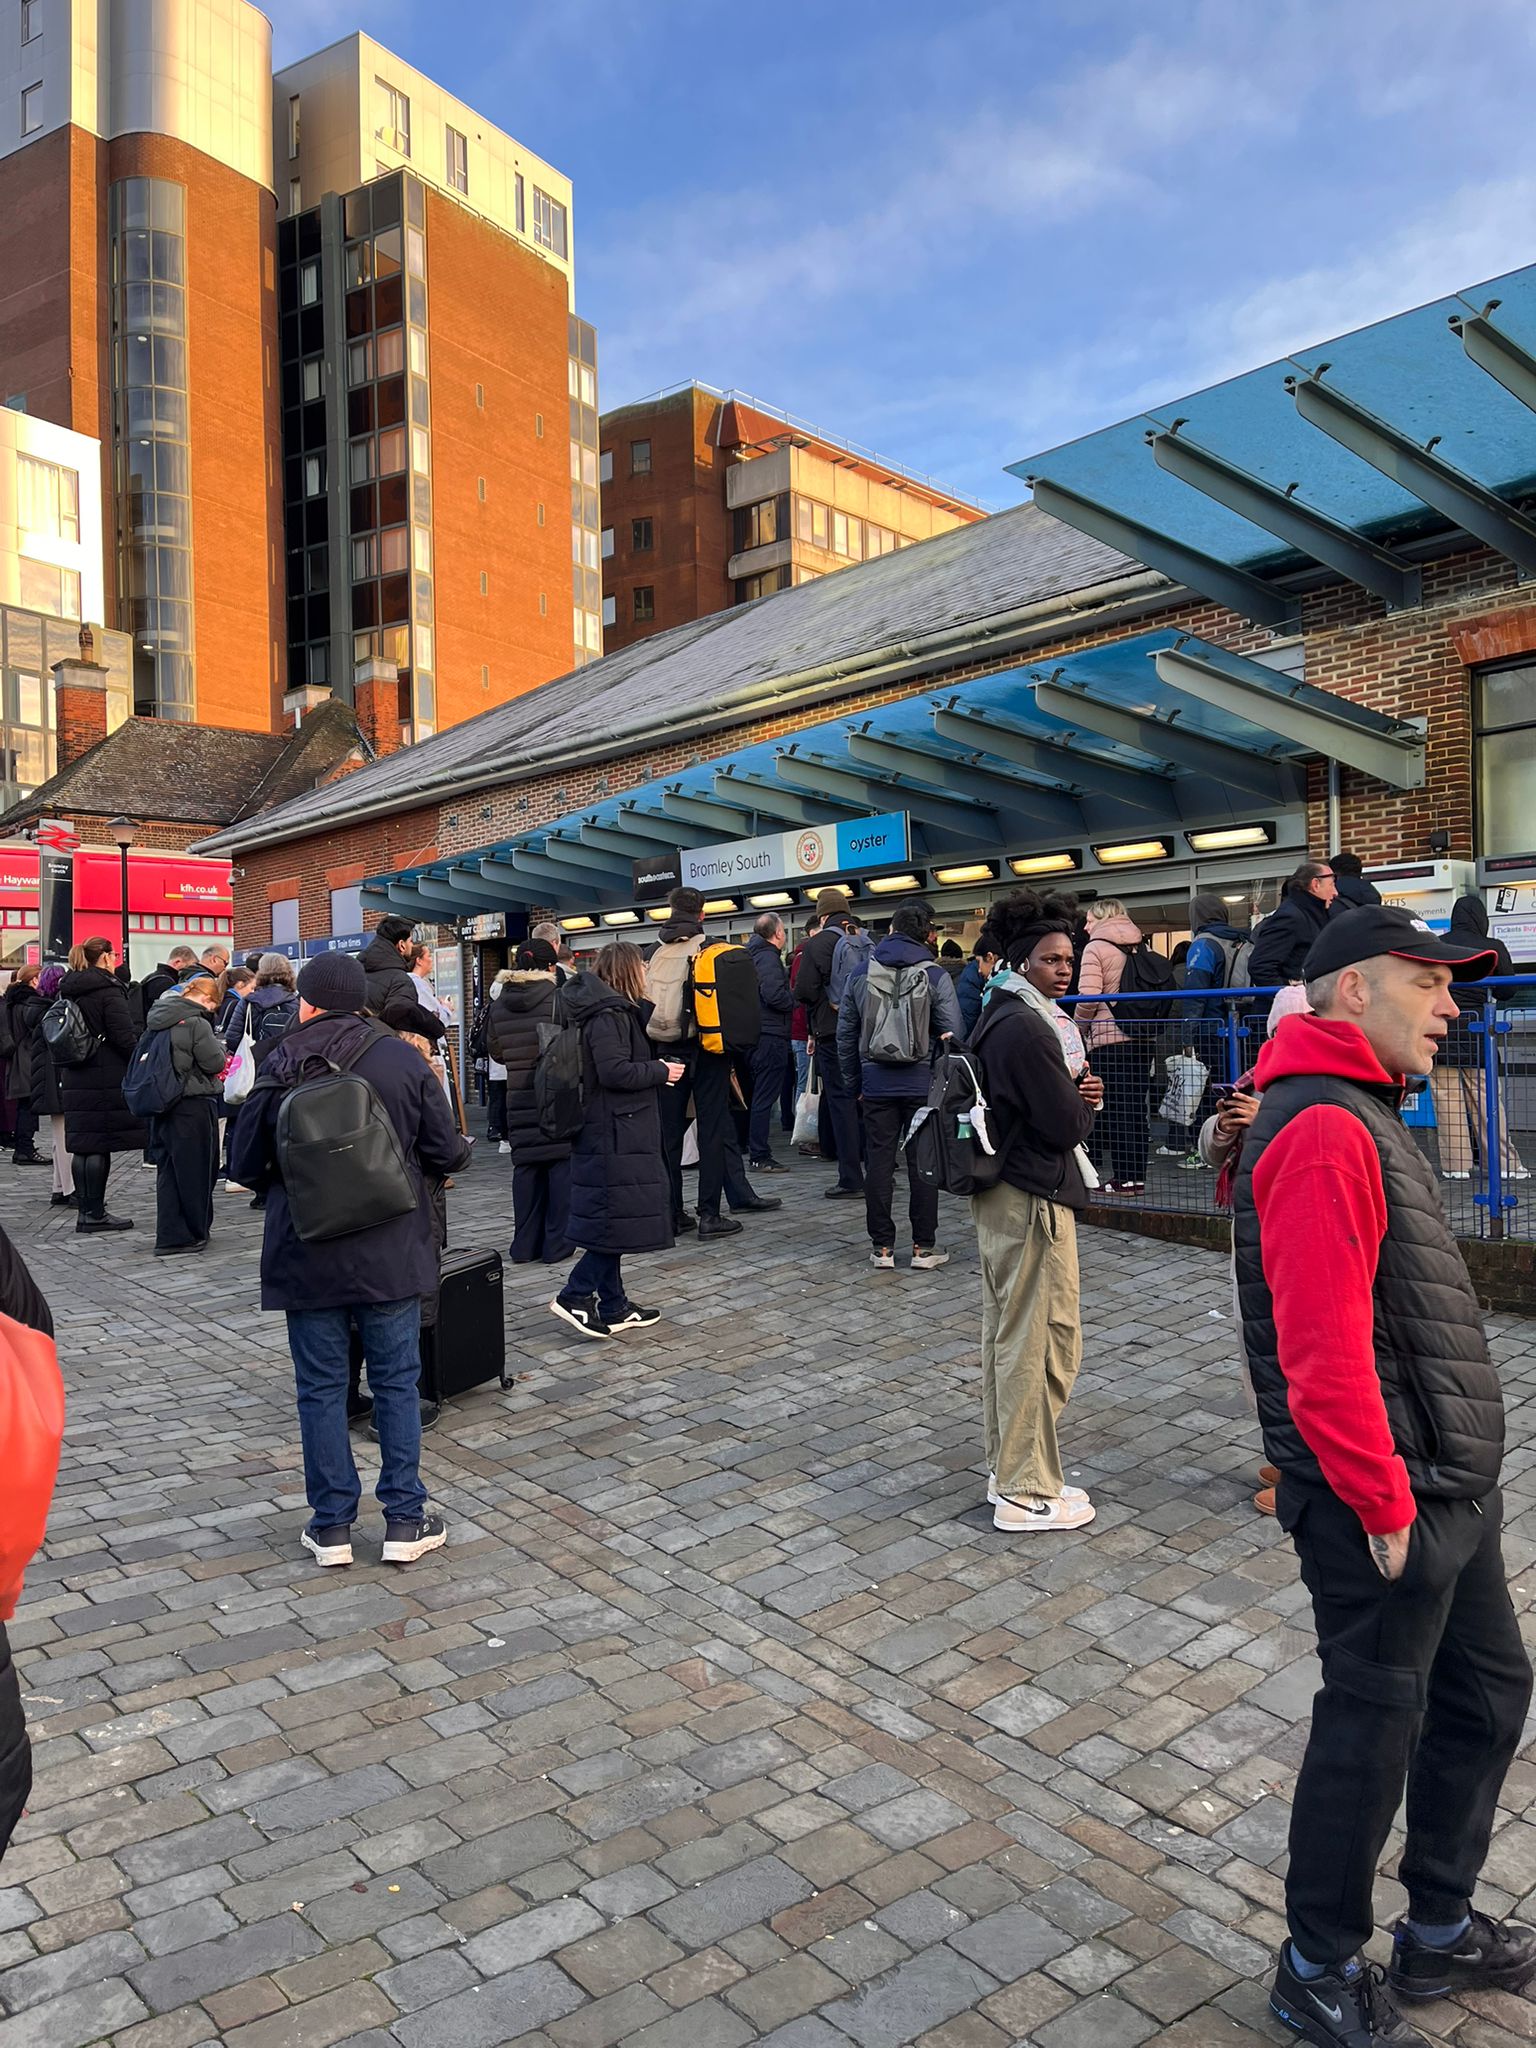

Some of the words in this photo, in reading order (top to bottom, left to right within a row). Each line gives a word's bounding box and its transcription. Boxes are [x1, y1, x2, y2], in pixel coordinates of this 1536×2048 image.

[850, 834, 887, 853] oyster
[690, 858, 734, 878] Bromley
[736, 851, 771, 871] South
[3, 875, 40, 886] Haywar
[180, 883, 218, 894] kfh.co.uk
[1383, 898, 1406, 907] KETS
